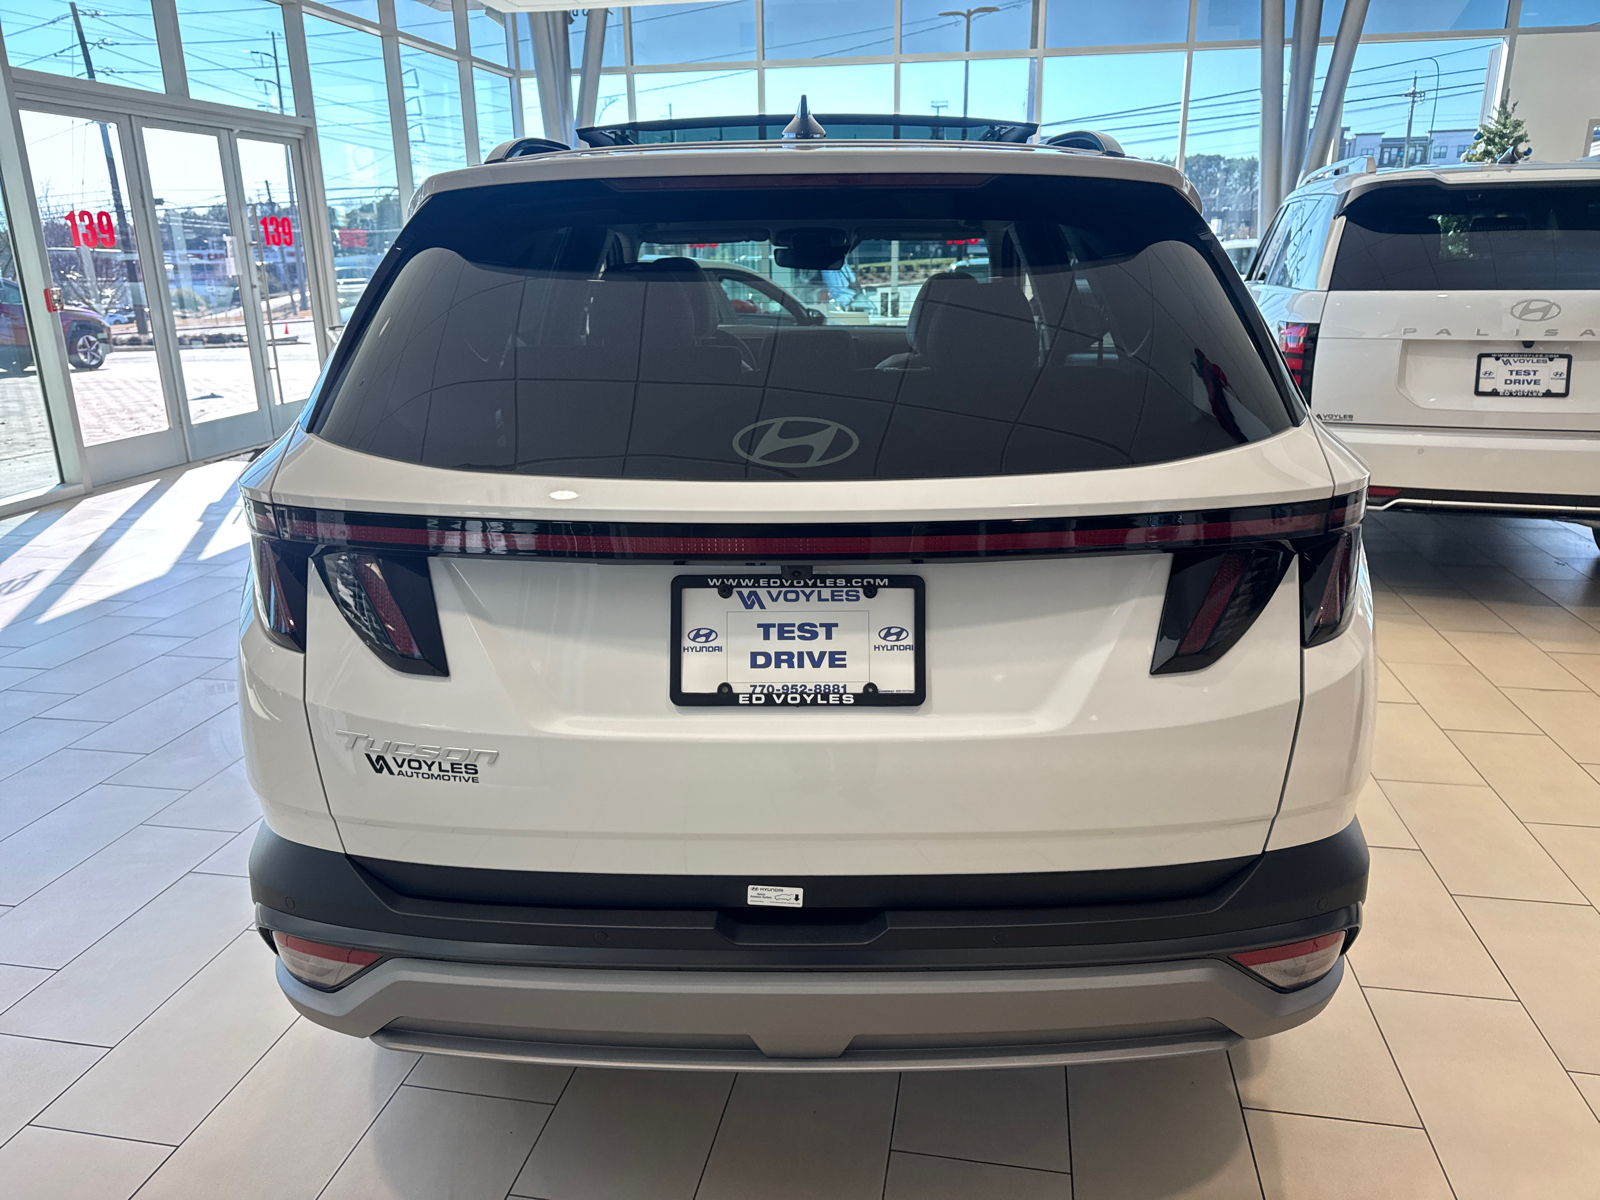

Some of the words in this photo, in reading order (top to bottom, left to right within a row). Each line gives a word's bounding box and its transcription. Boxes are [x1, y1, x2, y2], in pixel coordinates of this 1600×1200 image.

[64, 210, 116, 248] 139
[260, 216, 293, 247] 139
[1402, 327, 1596, 337] PALISA
[1504, 378, 1541, 386] DRIVE
[766, 589, 860, 602] VOYLES
[757, 622, 839, 641] TEST
[750, 651, 847, 669] DRIVE
[750, 684, 847, 693] 770-952-8881
[739, 694, 766, 704] ED
[772, 694, 855, 704] VOYLES
[392, 756, 479, 775] VOYLES
[397, 770, 479, 783] AUTOMOTIVE
